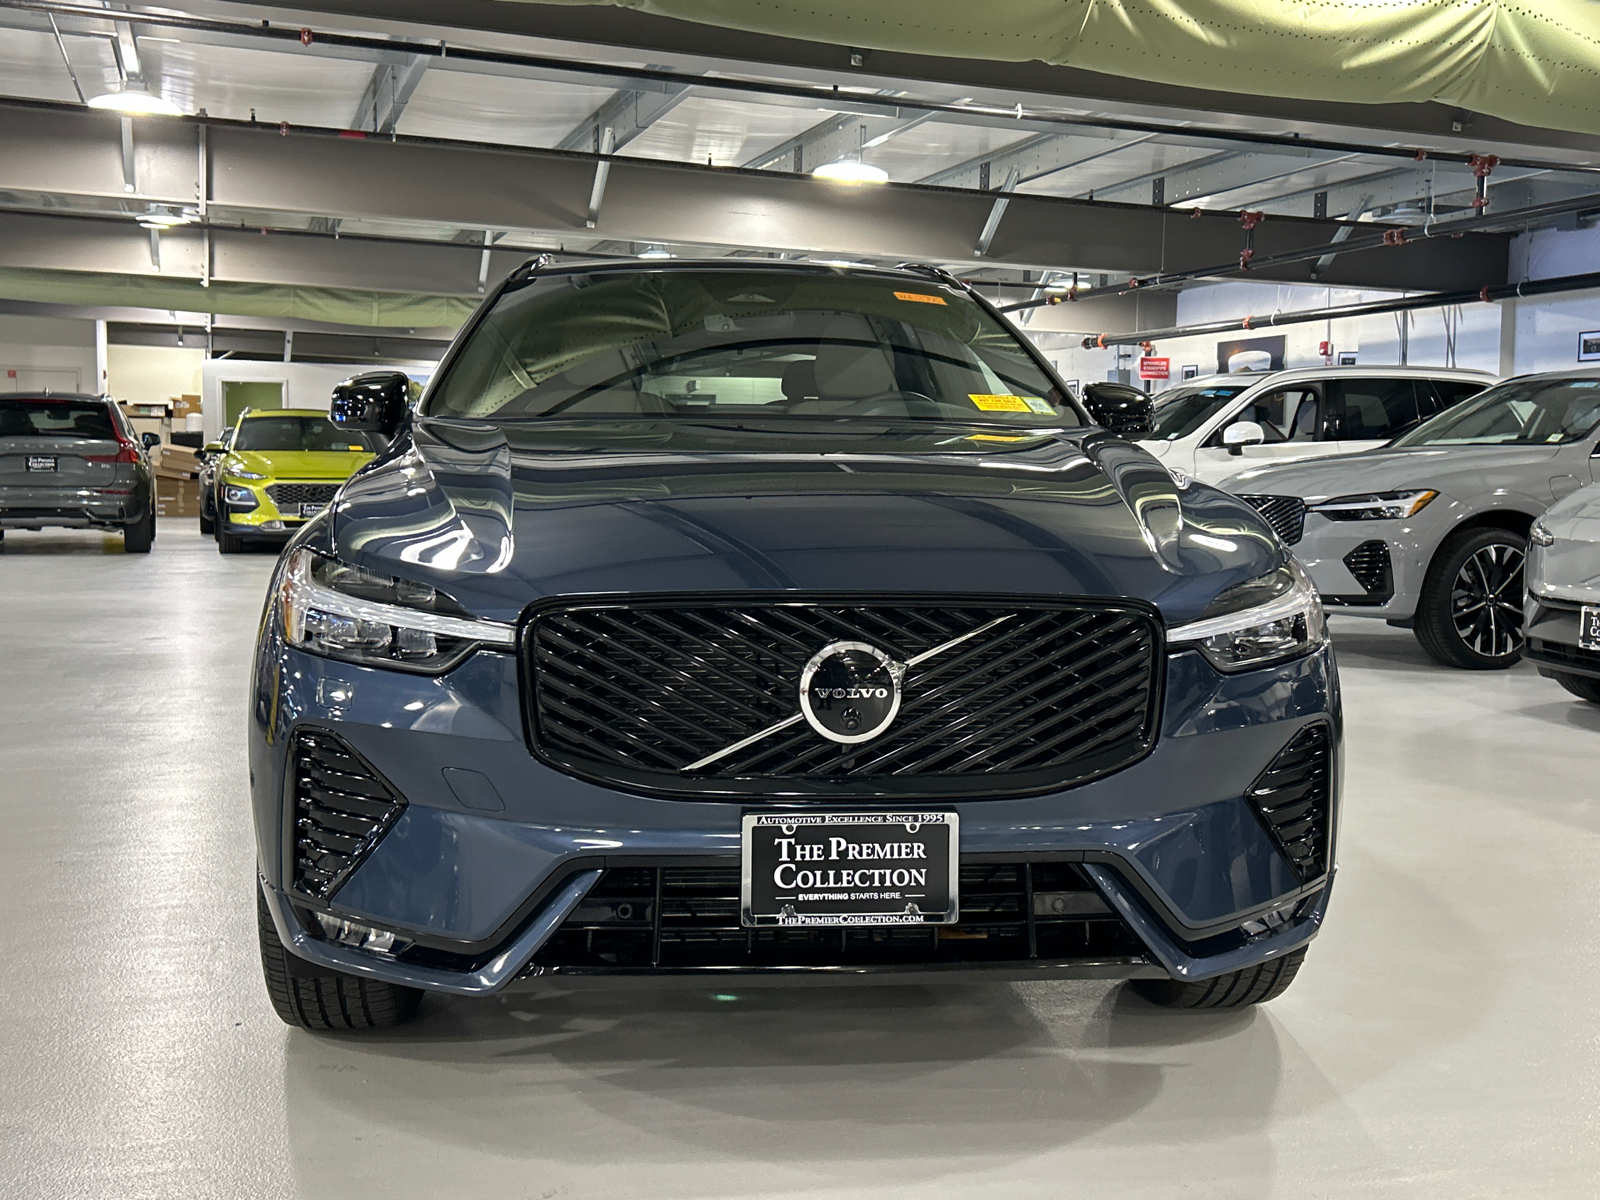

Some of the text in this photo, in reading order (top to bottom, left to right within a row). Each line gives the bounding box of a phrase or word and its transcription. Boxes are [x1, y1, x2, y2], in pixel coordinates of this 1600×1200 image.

[814, 687, 888, 699] VOLVO
[759, 814, 944, 825] AUTOMOTIVE EXCELLENCE SINCE 1995
[774, 836, 927, 862] THE PREMIER
[773, 863, 927, 889] COLLECTION
[798, 893, 849, 901] EVERYTHING
[850, 892, 878, 900] STARTS
